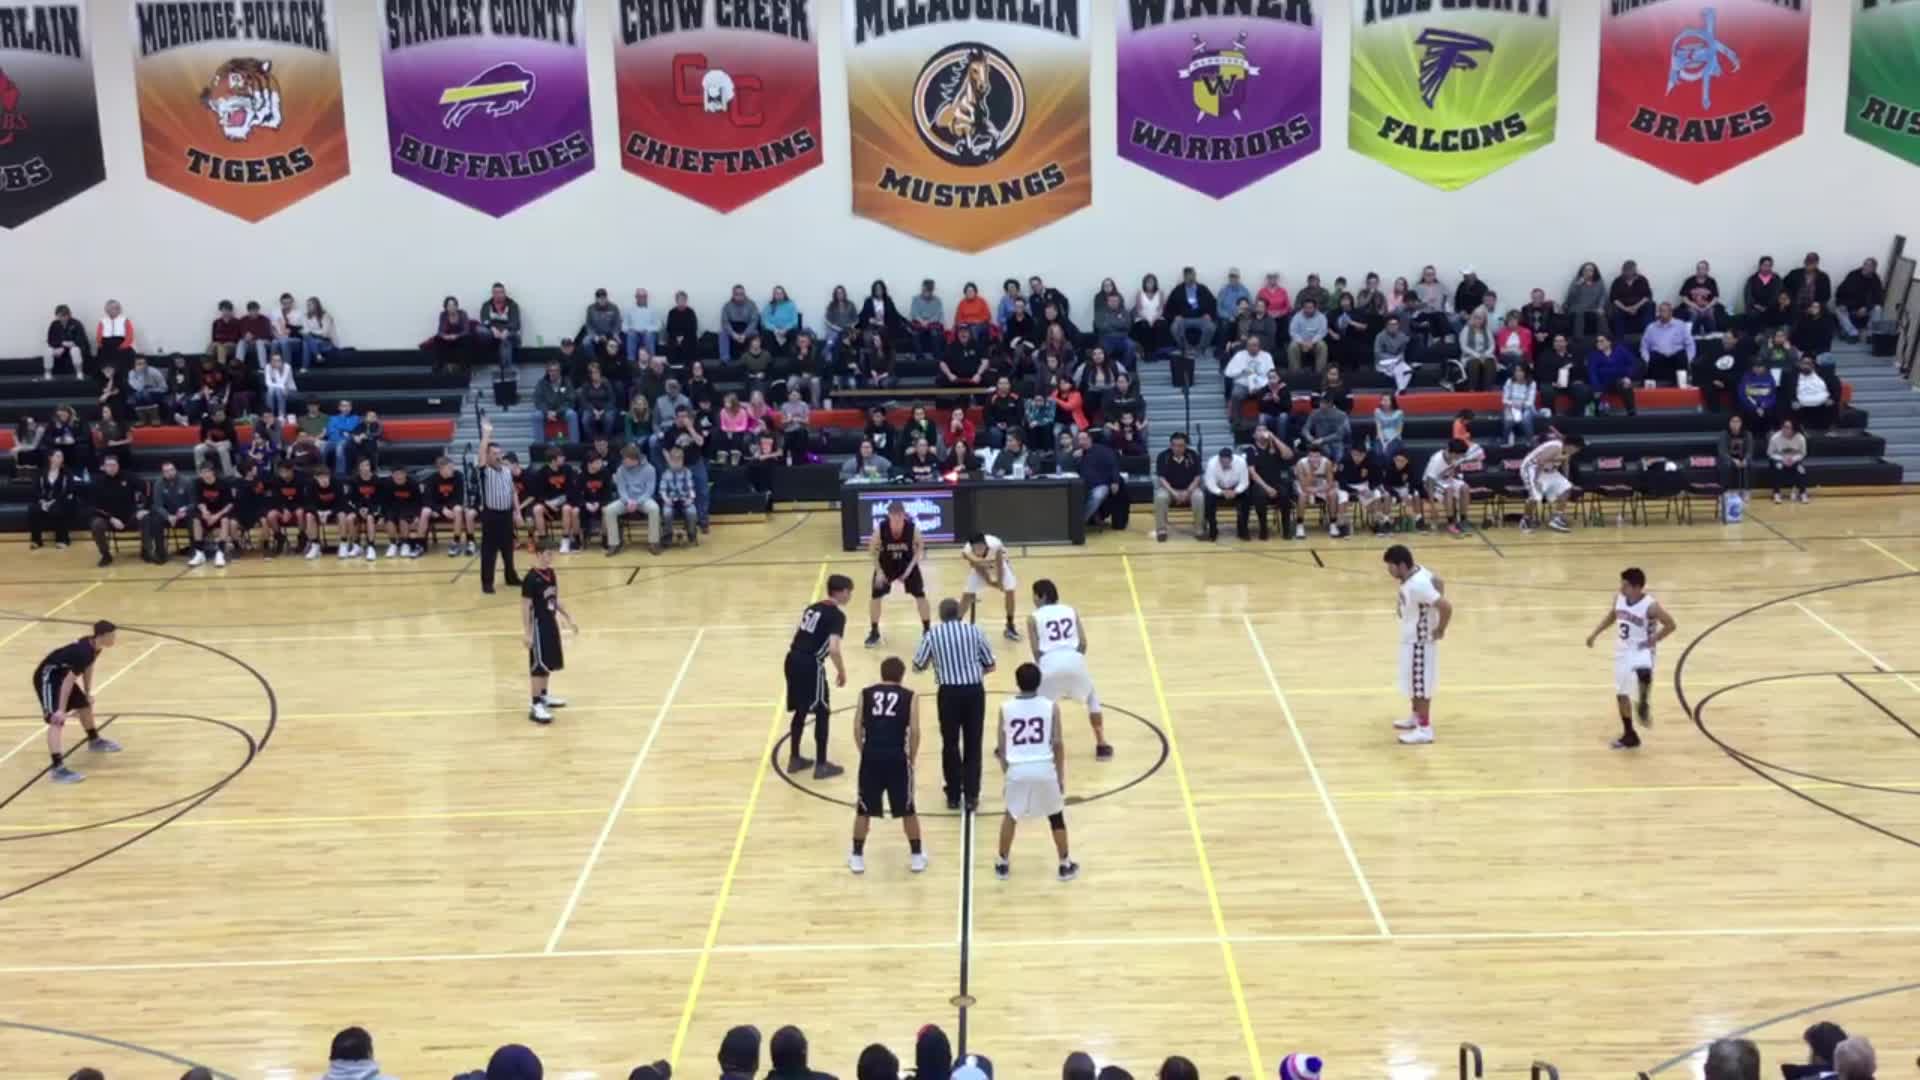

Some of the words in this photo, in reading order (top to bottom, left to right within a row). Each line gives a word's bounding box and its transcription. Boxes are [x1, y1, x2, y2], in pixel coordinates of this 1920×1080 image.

[138, 0, 328, 56] MOBRIDGE-POLLOCK
[386, 0, 482, 50] STANLEY
[489, 0, 575, 46] COUNTY
[620, 0, 704, 46] CROW
[715, 0, 809, 42] CREEK
[1130, 114, 1312, 161] WARRIORS
[1377, 112, 1527, 152] FALCONS
[1629, 103, 1774, 142] BRAVES
[187, 146, 314, 184] TIGERS
[398, 133, 588, 180] BUFFALOES
[626, 128, 815, 174] CHIEFTAINS
[878, 163, 1066, 209] MUSTANGS
[1046, 618, 1073, 641] 32
[1619, 623, 1630, 640] 3
[872, 692, 898, 716] 32
[1010, 717, 1045, 745] 23
